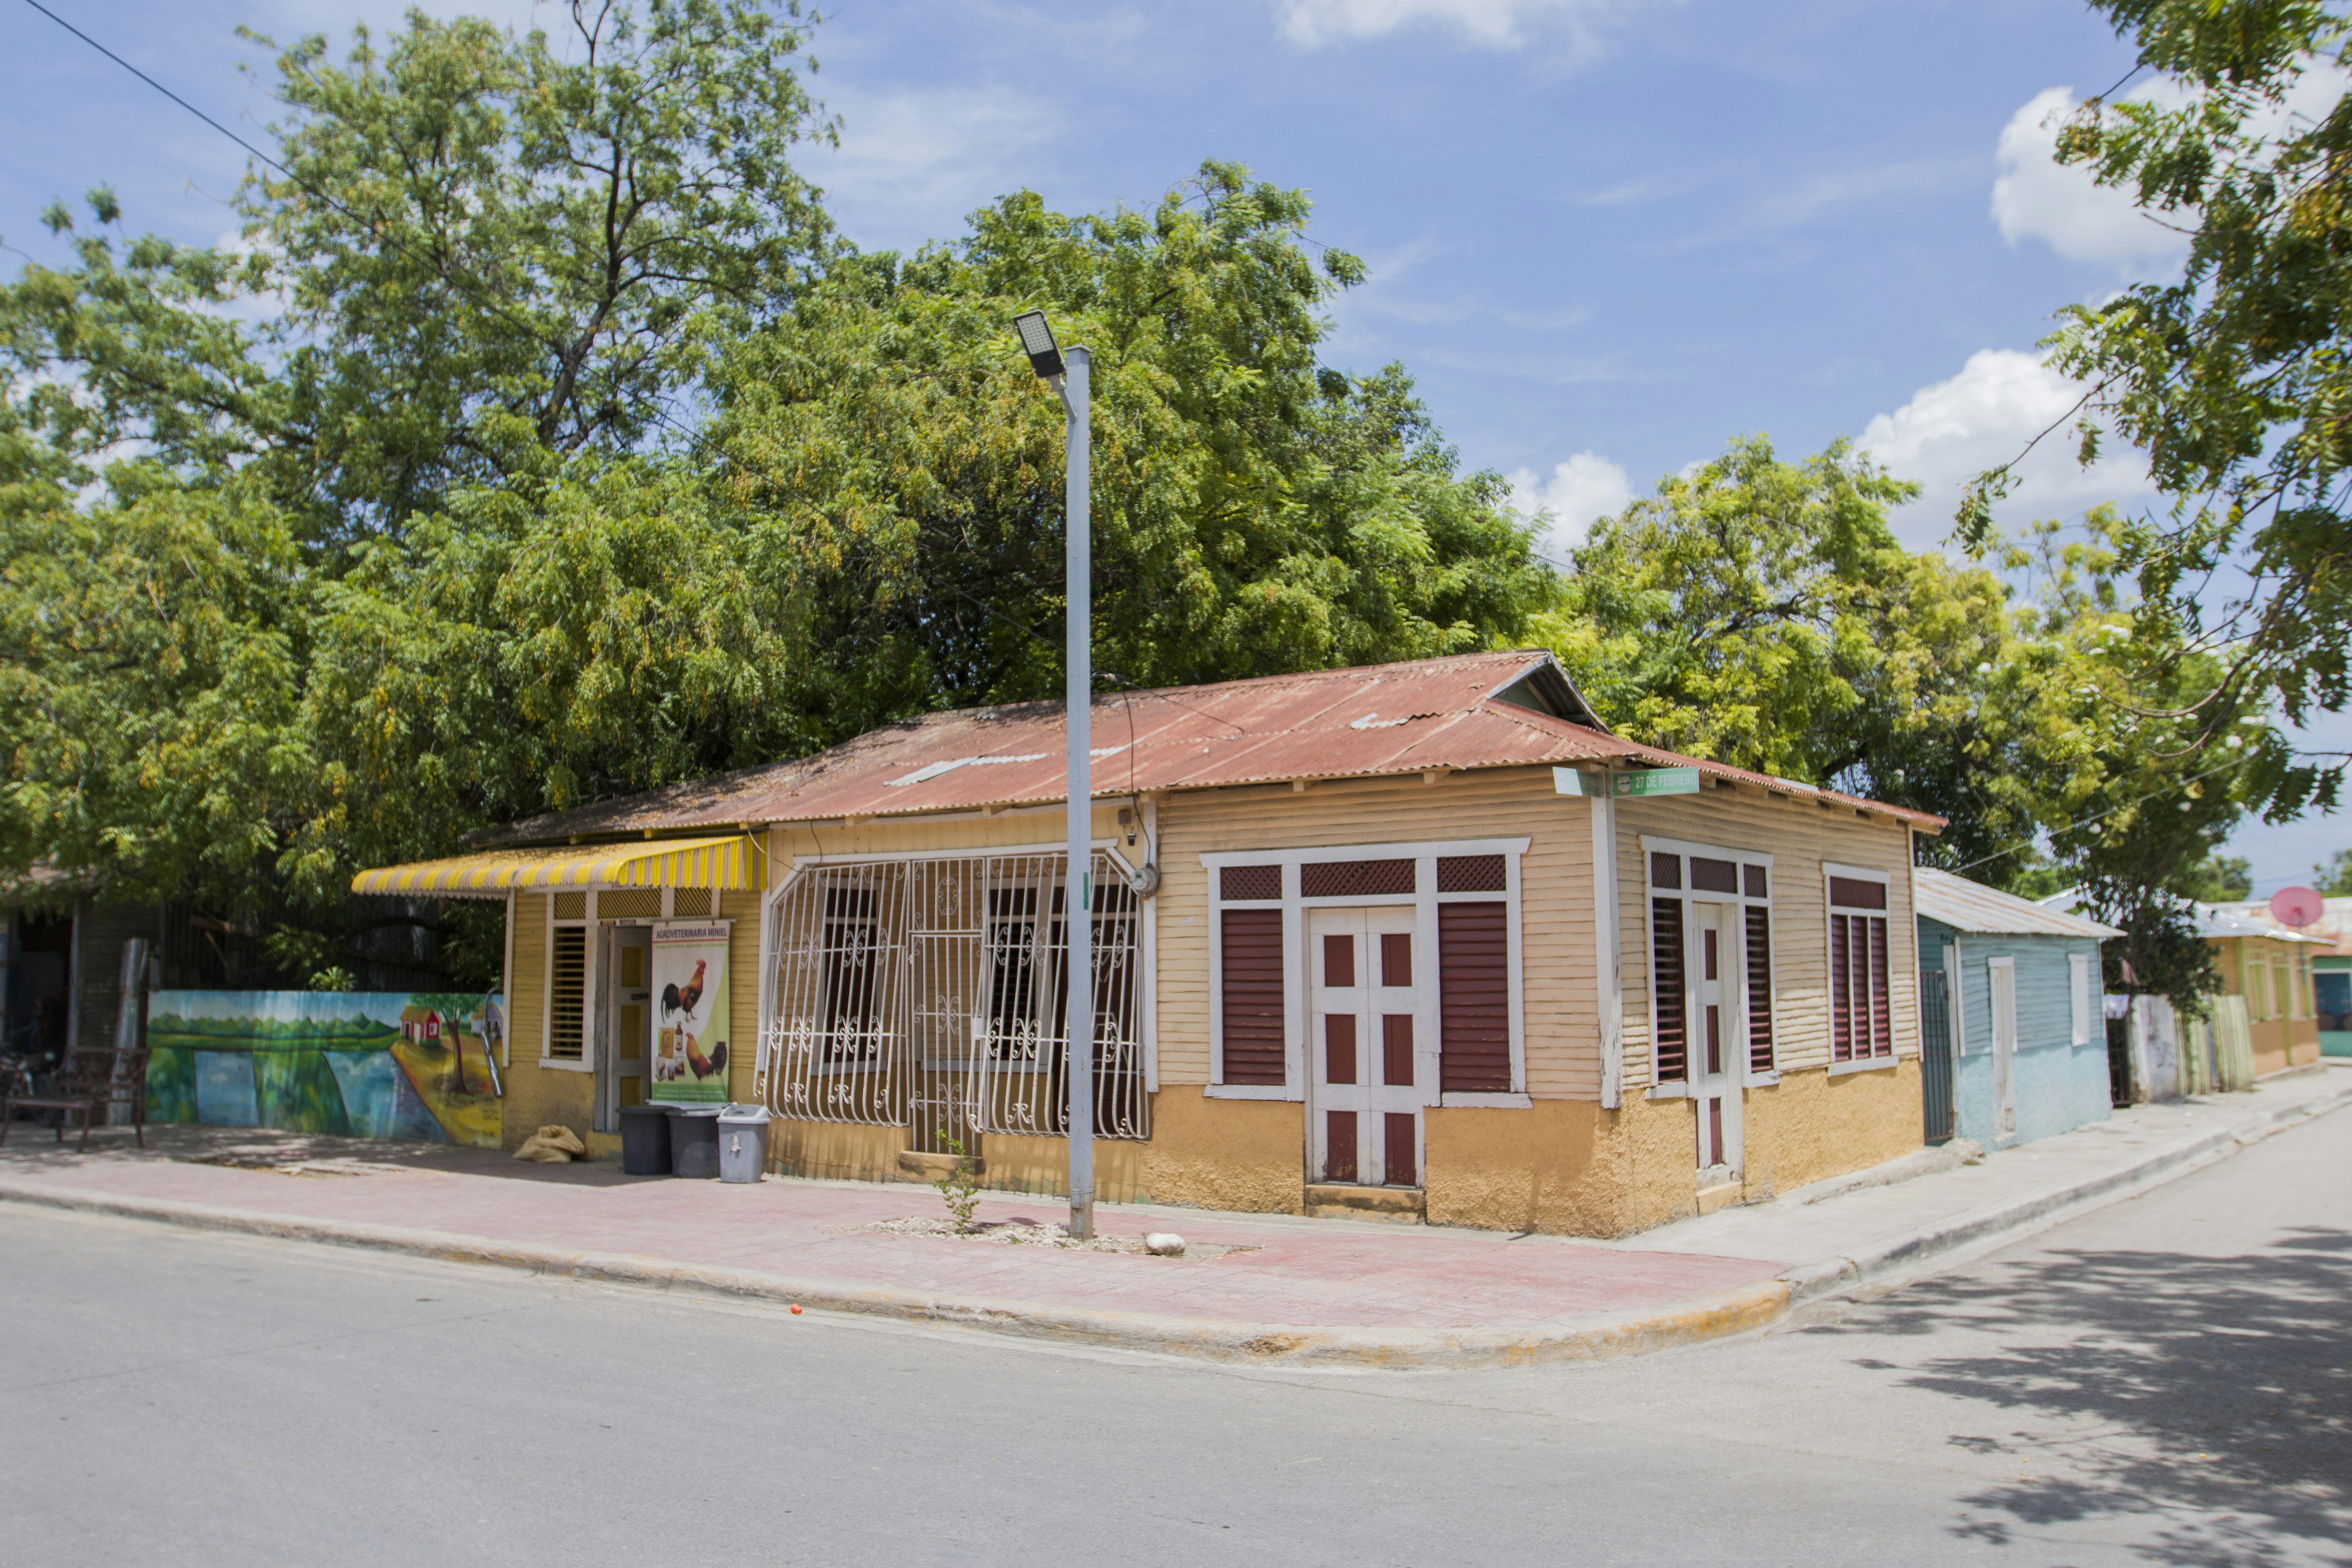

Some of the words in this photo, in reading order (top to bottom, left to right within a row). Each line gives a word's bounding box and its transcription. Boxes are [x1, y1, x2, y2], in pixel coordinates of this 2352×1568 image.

[1636, 776, 1644, 788] 27
[1646, 775, 1657, 787] DE
[1659, 773, 1697, 786] FEBRERO
[656, 928, 706, 939] AGROVETERINARIA
[708, 928, 727, 937] MINIEL
